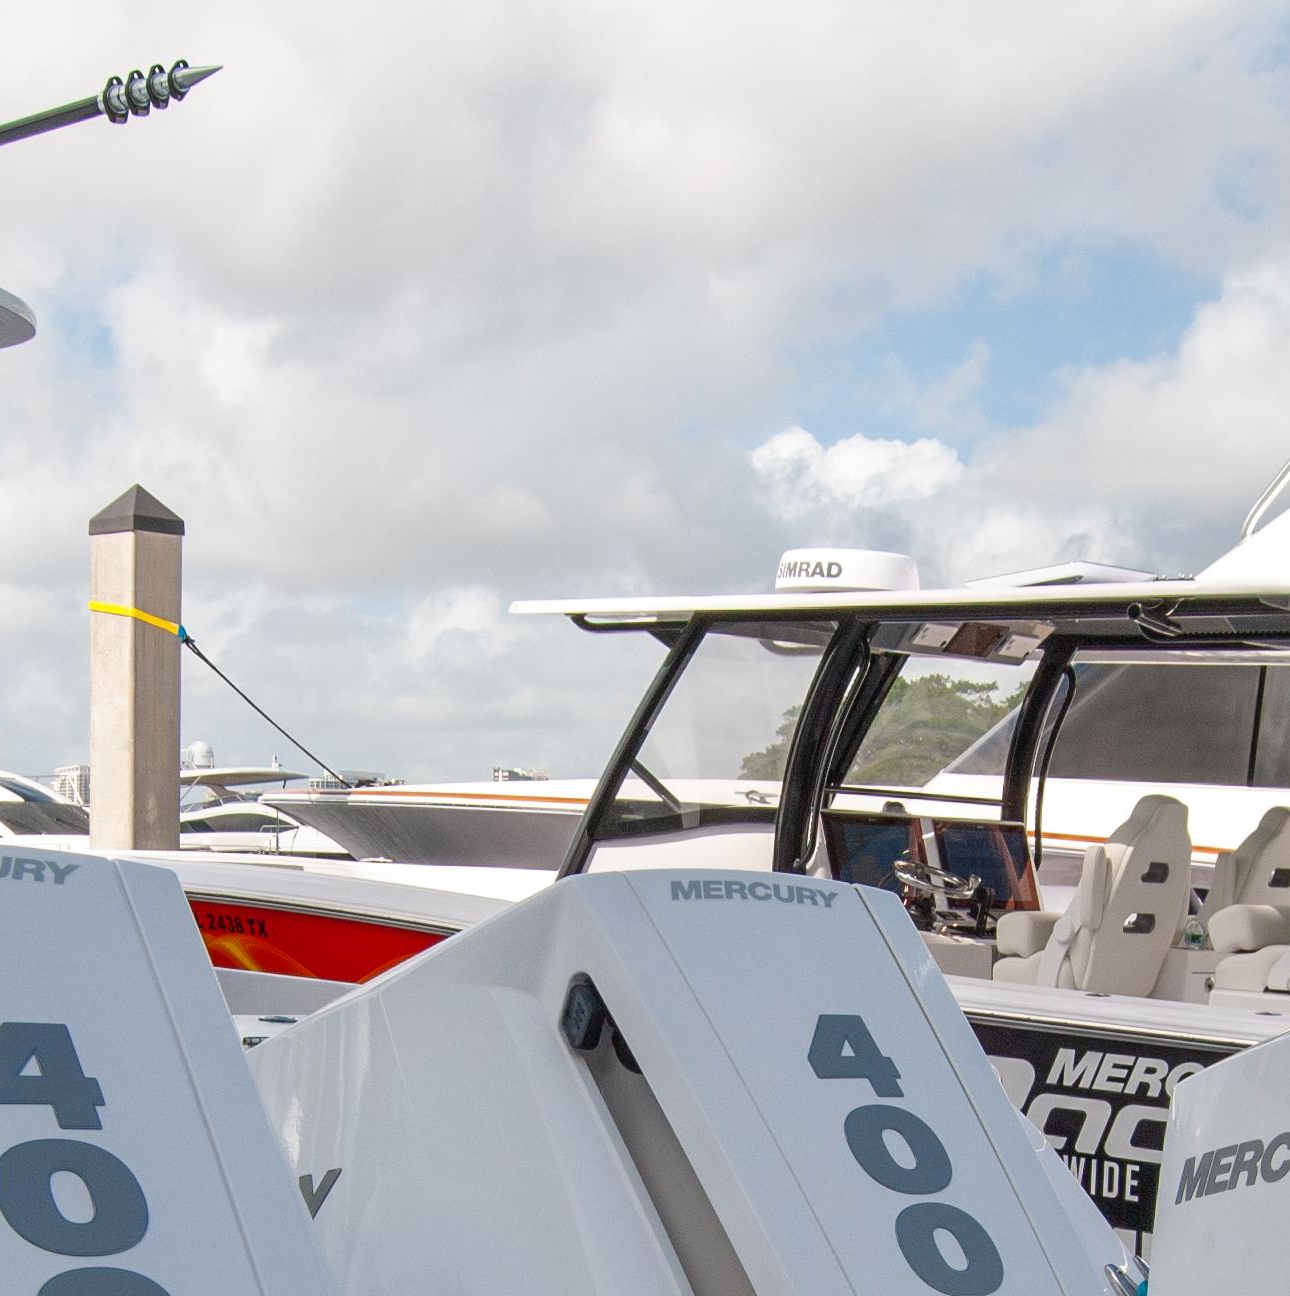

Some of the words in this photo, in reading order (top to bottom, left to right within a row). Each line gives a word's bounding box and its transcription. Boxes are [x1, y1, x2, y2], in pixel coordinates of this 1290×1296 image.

[777, 561, 843, 579] SIMRAD
[670, 880, 839, 908] MERCURY
[206, 912, 244, 934] 2438
[247, 918, 270, 939] TX
